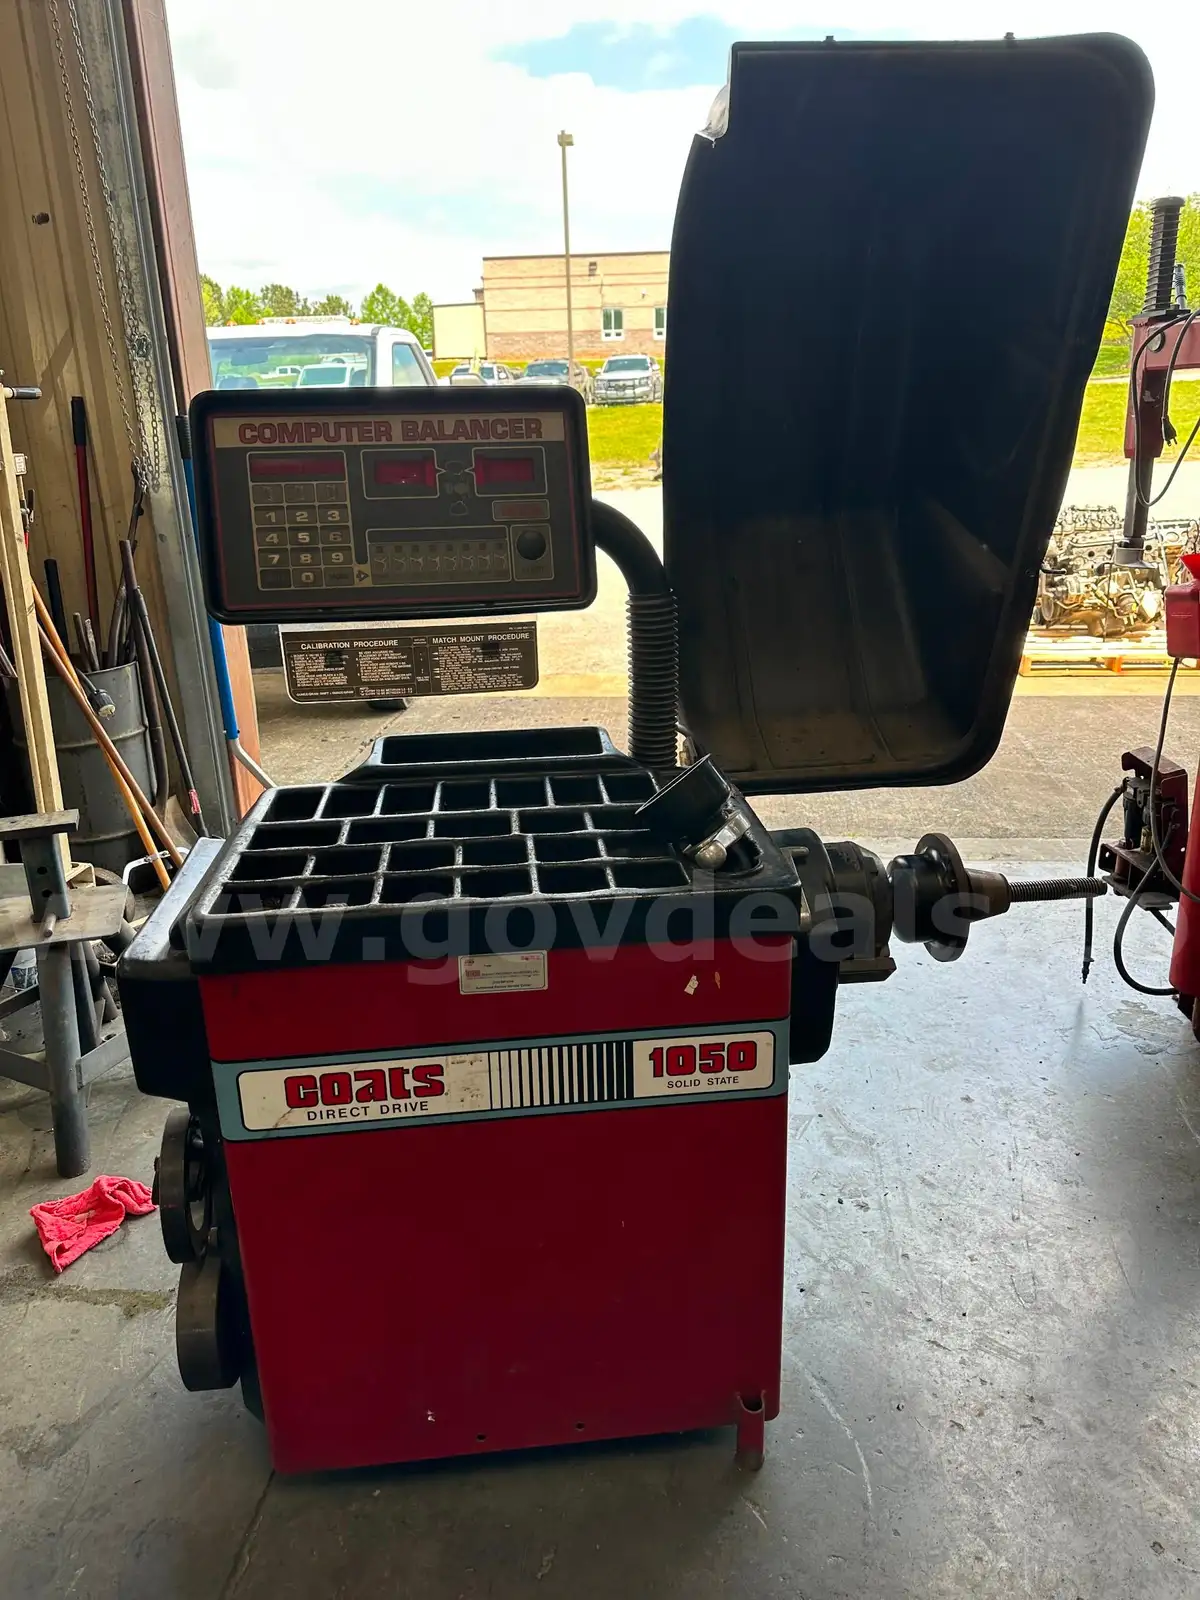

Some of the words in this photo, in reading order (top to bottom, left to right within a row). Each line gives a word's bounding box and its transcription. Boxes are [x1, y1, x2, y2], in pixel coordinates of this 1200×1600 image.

[238, 420, 393, 444] COMPUTER
[401, 417, 543, 442] BALANCER
[265, 511, 276, 523] 1
[295, 511, 309, 522] 2
[327, 510, 340, 521] 3
[265, 533, 279, 544] 4
[297, 532, 310, 543] 5
[329, 531, 342, 542] 6
[267, 554, 280, 565] 7
[299, 553, 312, 564] 8
[331, 552, 344, 563] 9
[301, 572, 315, 583] 0
[300, 641, 350, 650] CALIBRATION
[353, 639, 399, 648] PROCEDURE
[432, 636, 457, 644] MATCH
[459, 635, 485, 643] MOUNT
[487, 632, 530, 641] PROCEDURE
[648, 1040, 758, 1078] 1050
[667, 1078, 701, 1089] SOLID
[707, 1075, 740, 1086] STATE
[307, 1106, 370, 1121] DIRECT
[379, 1100, 429, 1115] DRIVE
